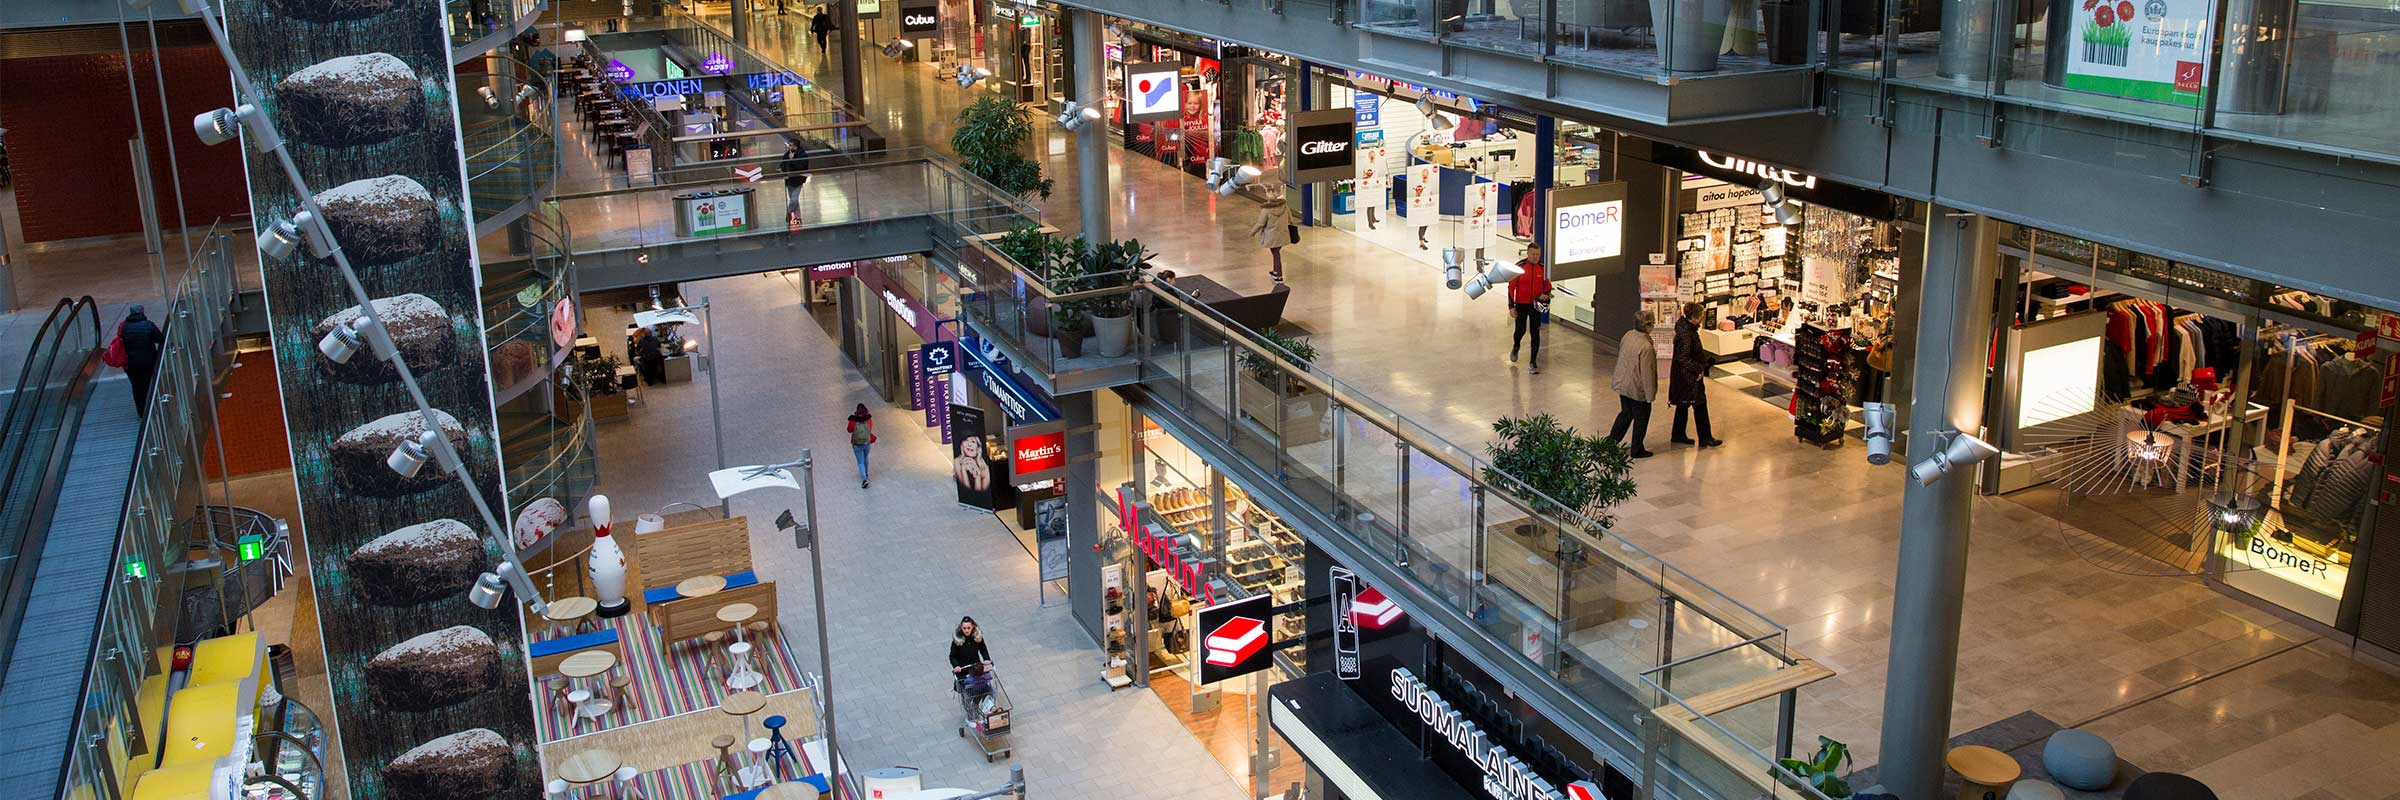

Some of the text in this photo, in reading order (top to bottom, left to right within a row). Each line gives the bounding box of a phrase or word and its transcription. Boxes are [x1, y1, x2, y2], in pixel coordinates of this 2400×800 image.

[905, 14, 935, 25] Cubus
[1301, 140, 1349, 155] Glitter
[1703, 191, 1726, 202] aitoa
[1560, 206, 1618, 229] BomeR
[1018, 443, 1061, 460] Martin's
[1116, 488, 1216, 608] Martin's
[2251, 537, 2327, 580] BomeR
[1391, 667, 1556, 800] SUOMALAINE
